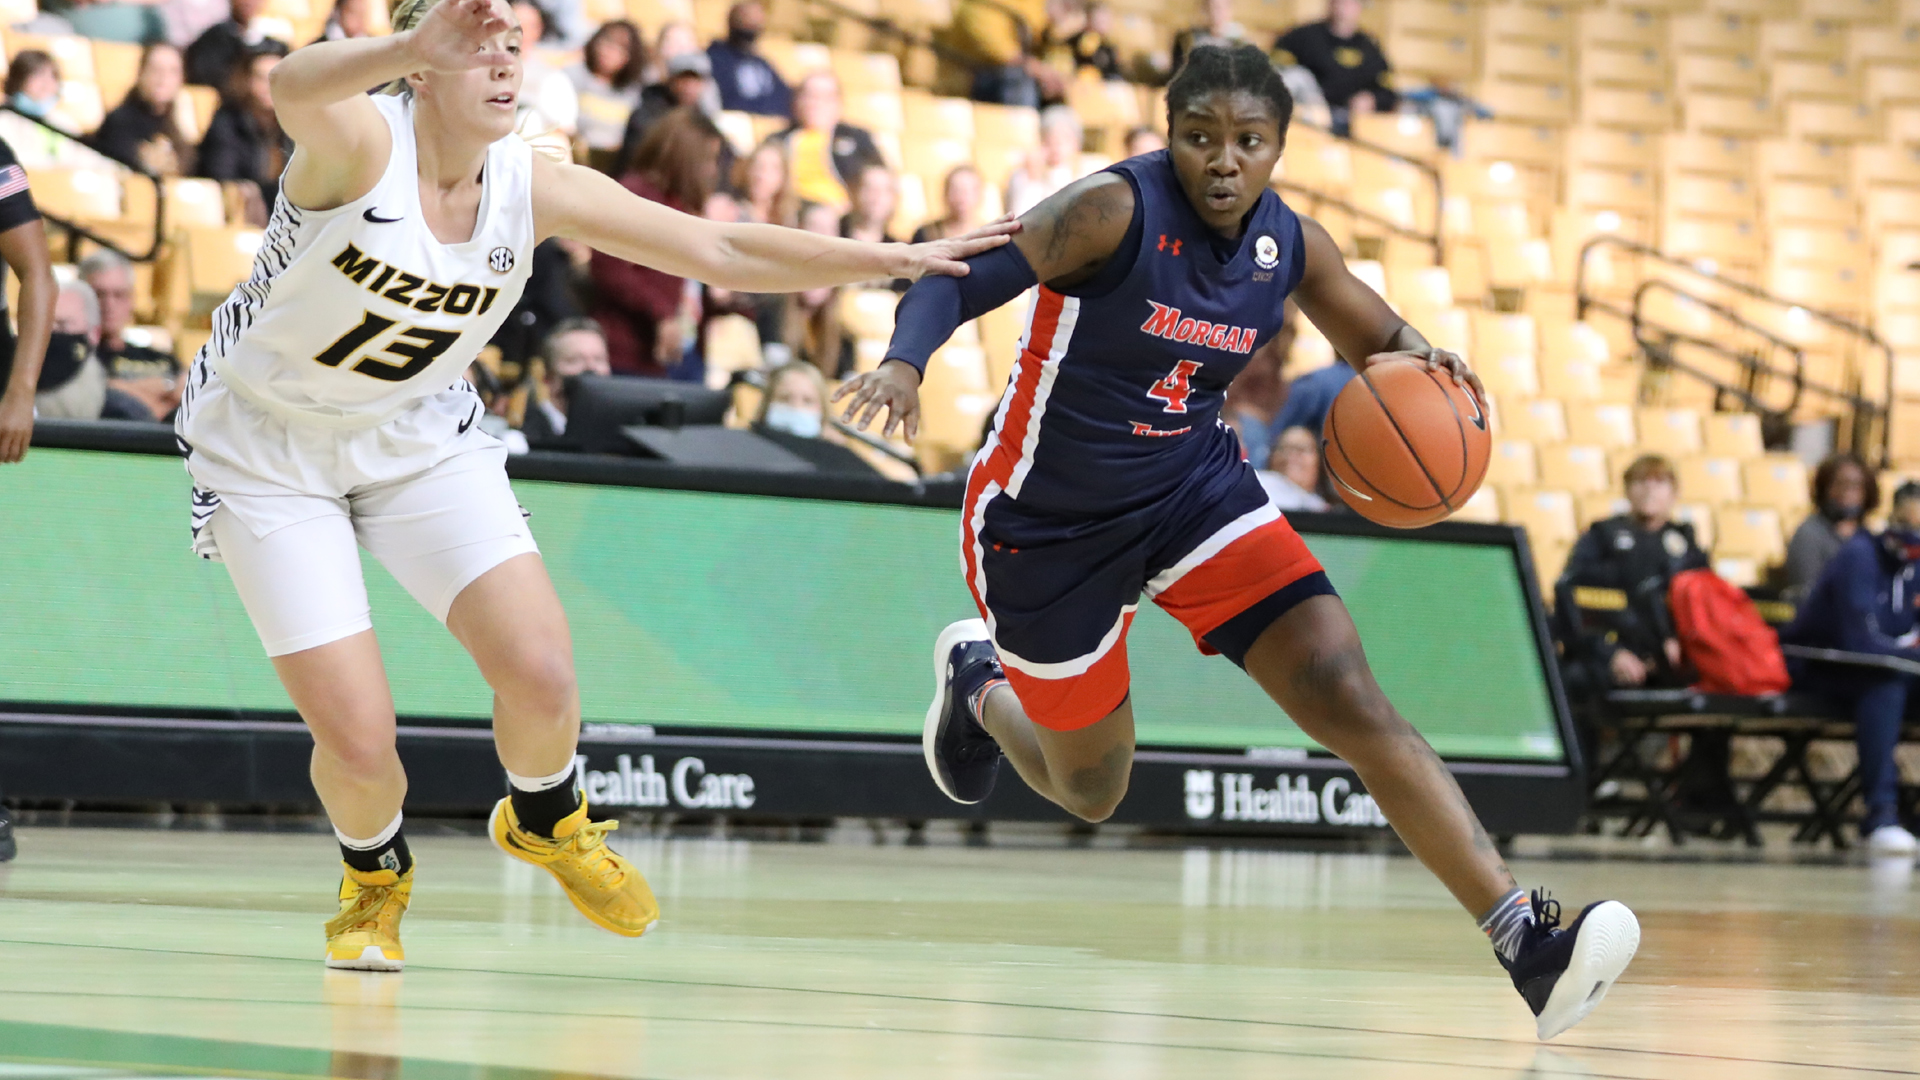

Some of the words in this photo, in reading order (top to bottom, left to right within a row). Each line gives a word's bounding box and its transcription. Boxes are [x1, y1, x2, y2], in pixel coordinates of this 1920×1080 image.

[490, 246, 514, 273] SEC
[312, 308, 463, 382] 13
[1140, 299, 1257, 354] MORGAN
[1146, 359, 1204, 413] 4
[671, 756, 755, 809] Care
[1219, 772, 1320, 823] Health
